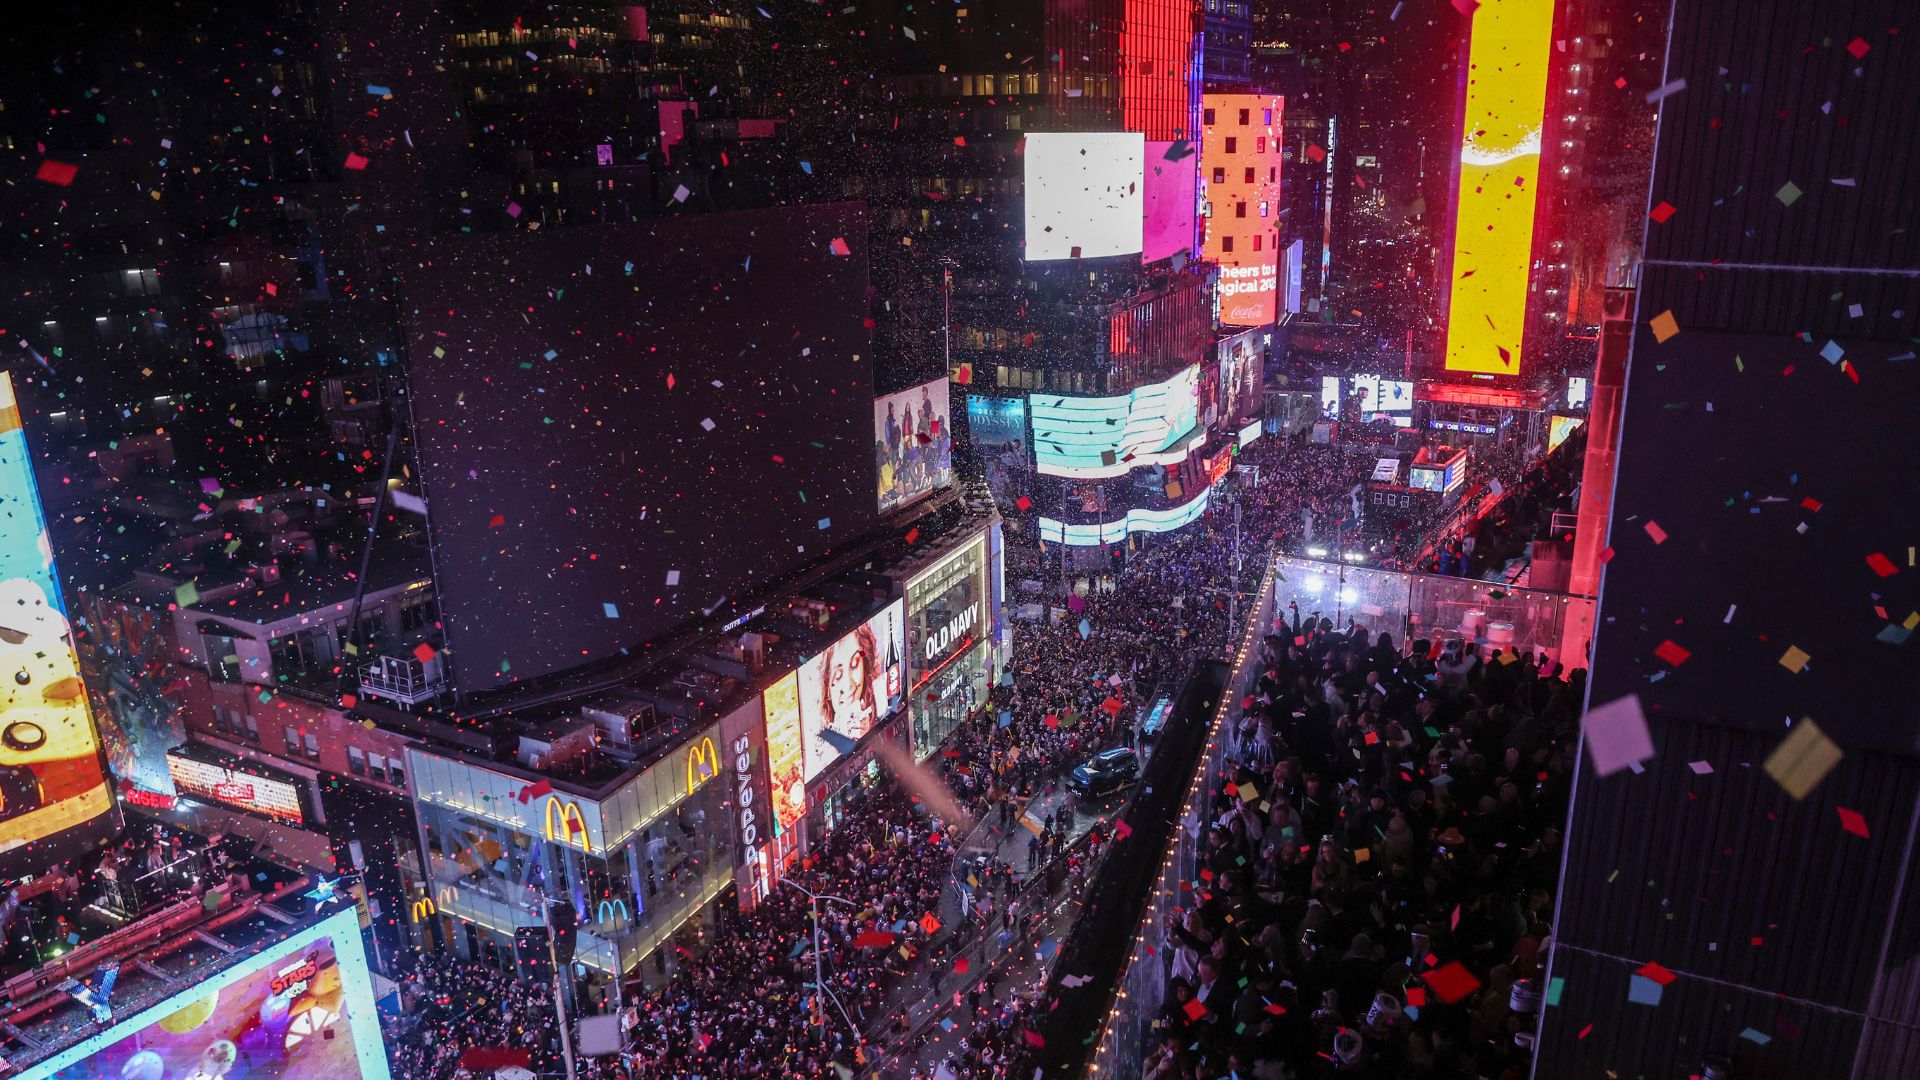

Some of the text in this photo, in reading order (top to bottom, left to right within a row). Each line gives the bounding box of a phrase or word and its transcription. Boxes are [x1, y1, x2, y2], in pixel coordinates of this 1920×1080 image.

[925, 601, 979, 660] OLD NAVY
[941, 682, 951, 700] OLD
[271, 960, 317, 996] STARS
